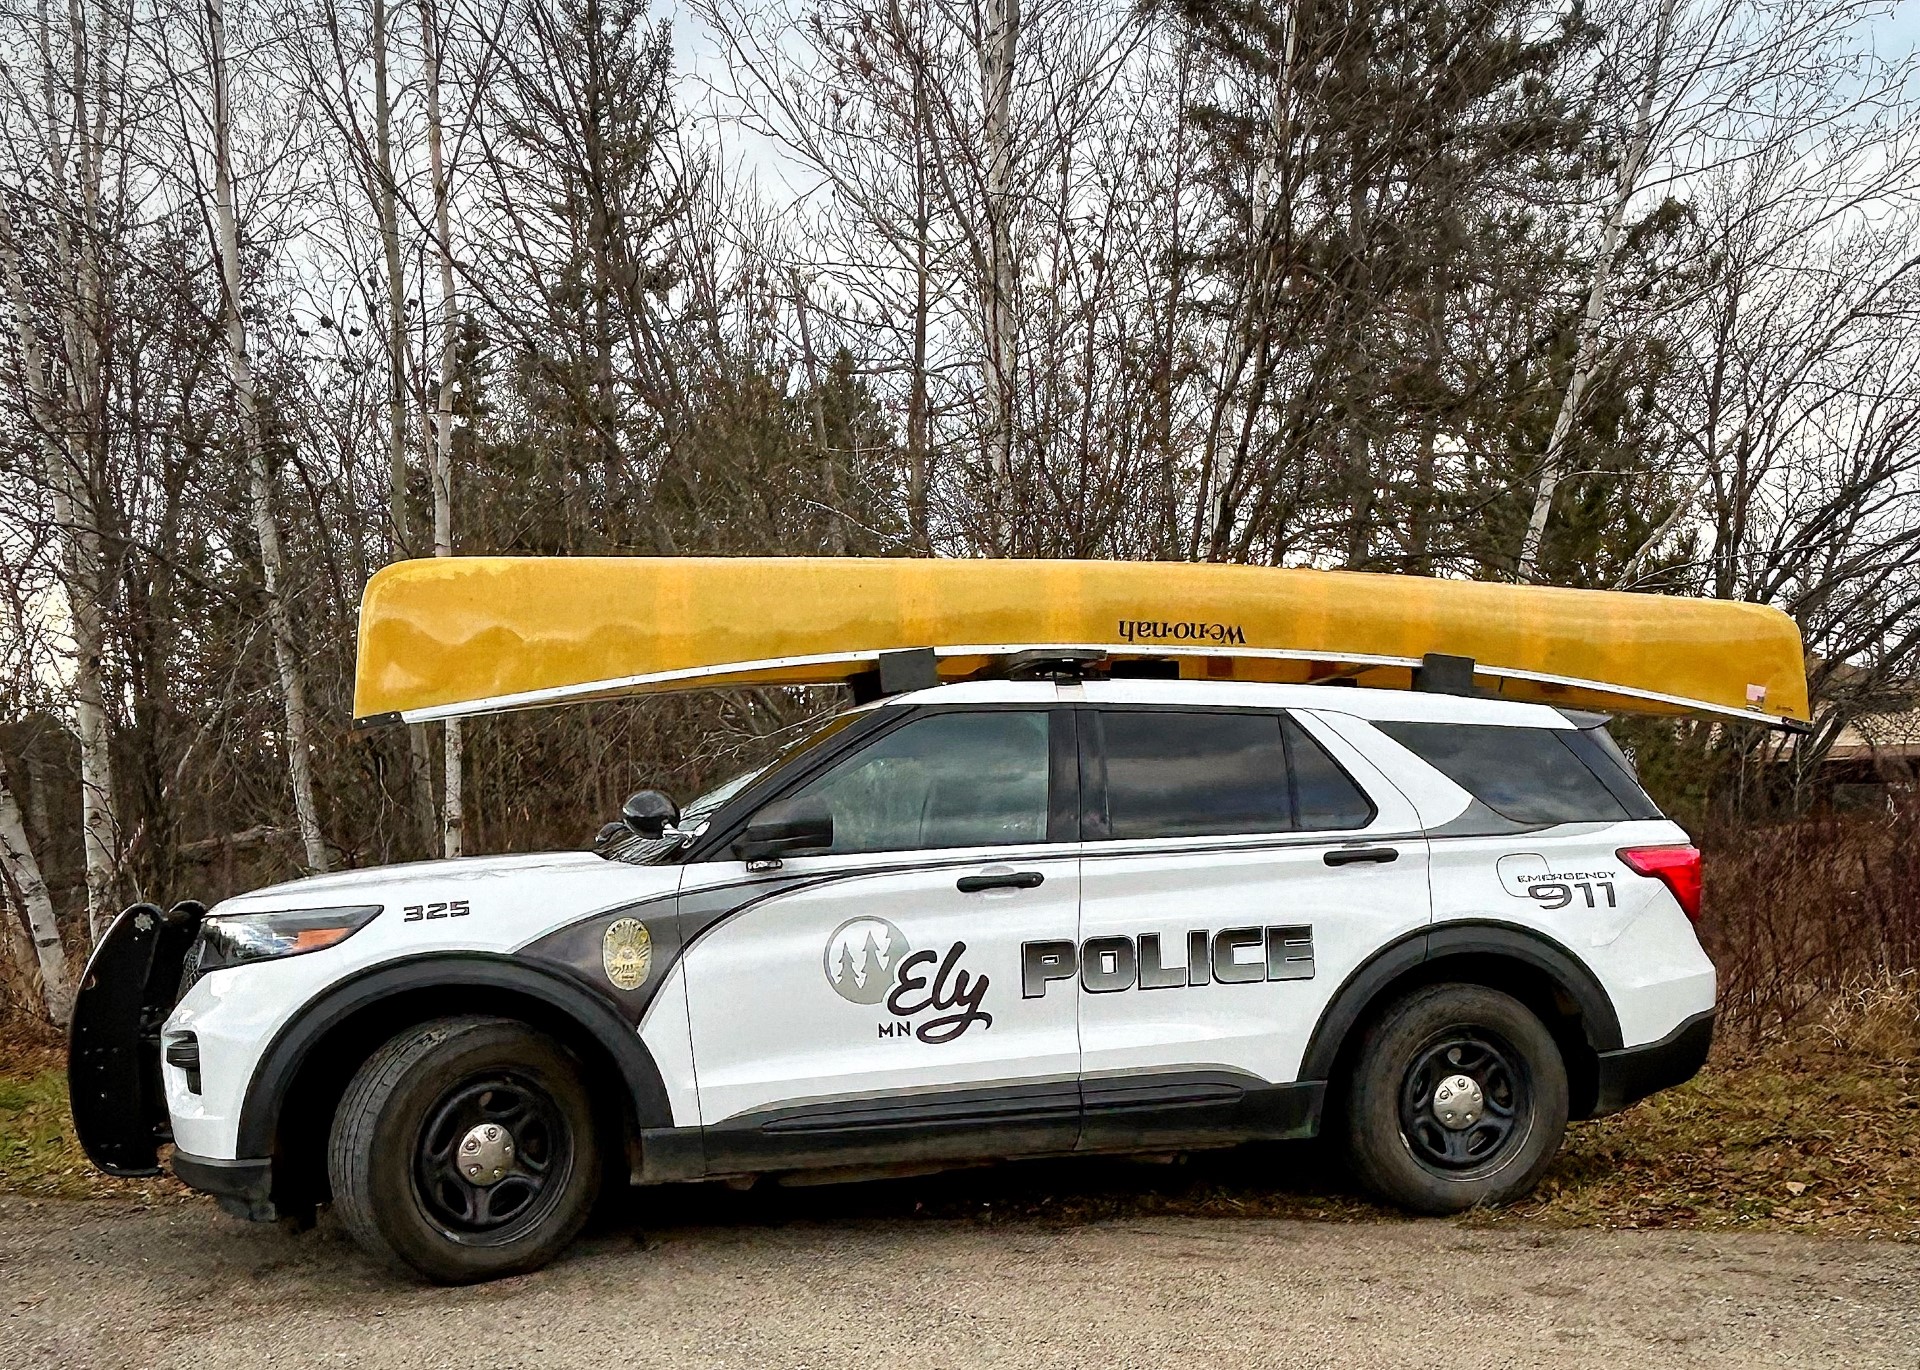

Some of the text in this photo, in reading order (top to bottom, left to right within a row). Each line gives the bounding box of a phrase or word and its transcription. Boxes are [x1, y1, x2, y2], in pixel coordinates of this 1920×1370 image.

[1528, 881, 1617, 910] 911
[403, 900, 470, 922] 325
[1022, 923, 1315, 999] POLICE
[887, 941, 993, 1044] Ely
[878, 1021, 911, 1038] MN
